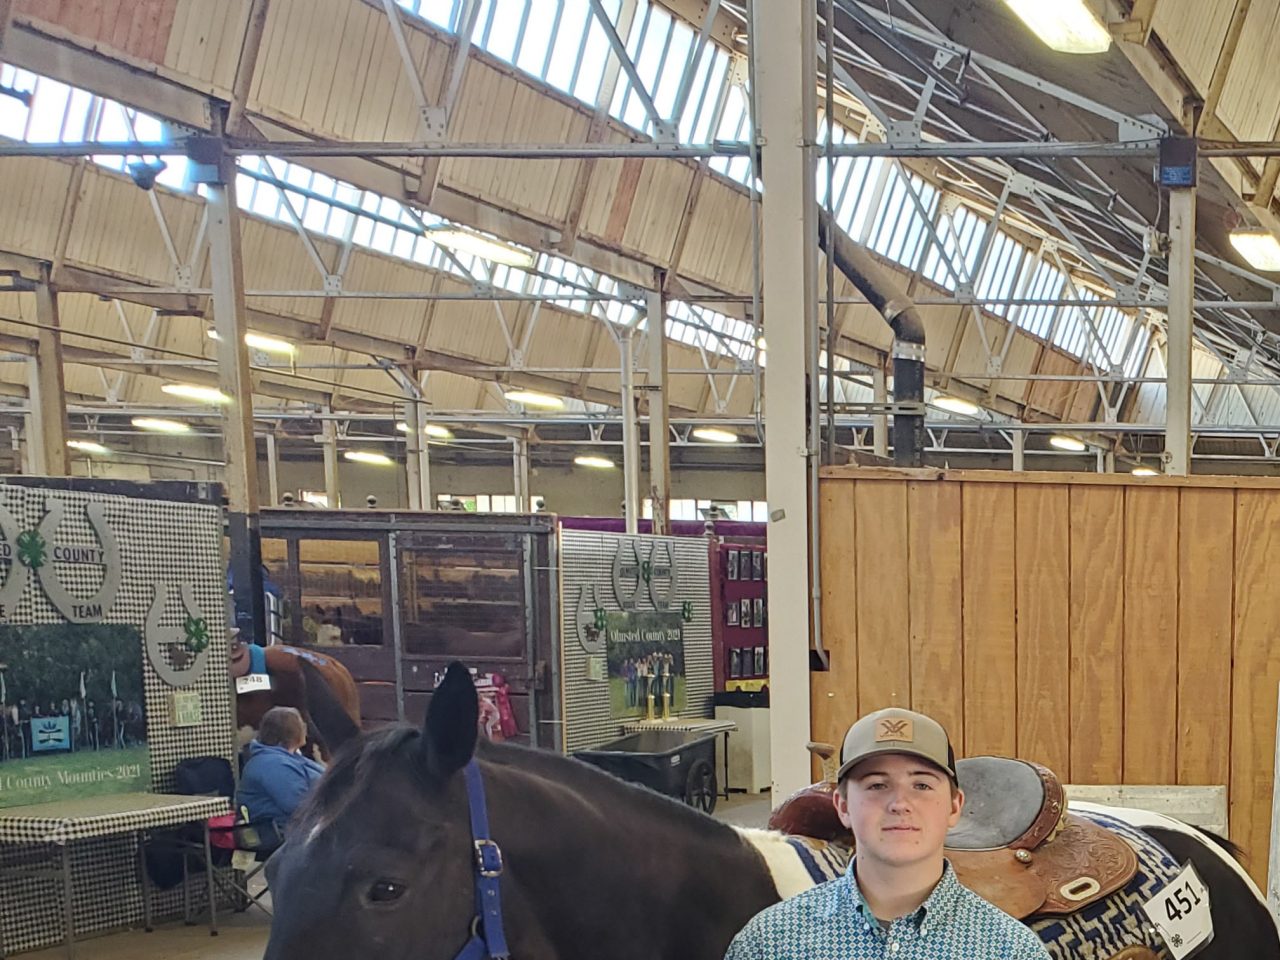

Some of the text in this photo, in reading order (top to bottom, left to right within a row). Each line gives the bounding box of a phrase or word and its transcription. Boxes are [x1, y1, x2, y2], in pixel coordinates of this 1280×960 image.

[53, 546, 104, 562] COUNTY
[72, 603, 102, 618] TEAM
[57, 766, 114, 785] Mounties
[115, 763, 140, 779] 2021
[1165, 880, 1201, 922] 451
